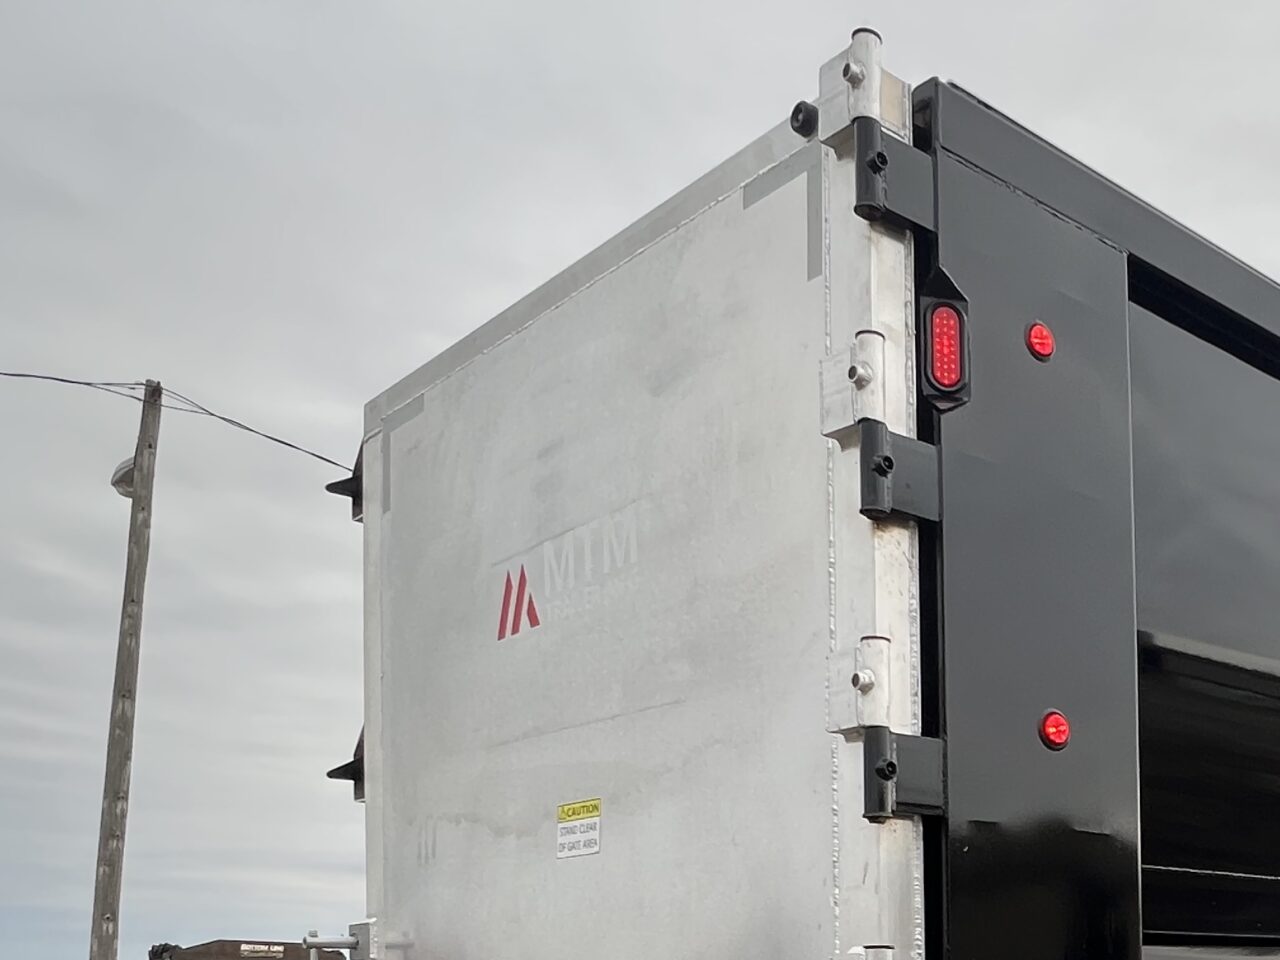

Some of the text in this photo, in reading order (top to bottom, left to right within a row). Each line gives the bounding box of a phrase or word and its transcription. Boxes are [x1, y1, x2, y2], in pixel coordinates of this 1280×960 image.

[543, 505, 640, 597] MTM
[566, 803, 599, 818] CAUTION
[579, 822, 598, 835] CLEAR
[558, 838, 598, 853] OF GATE AREA
